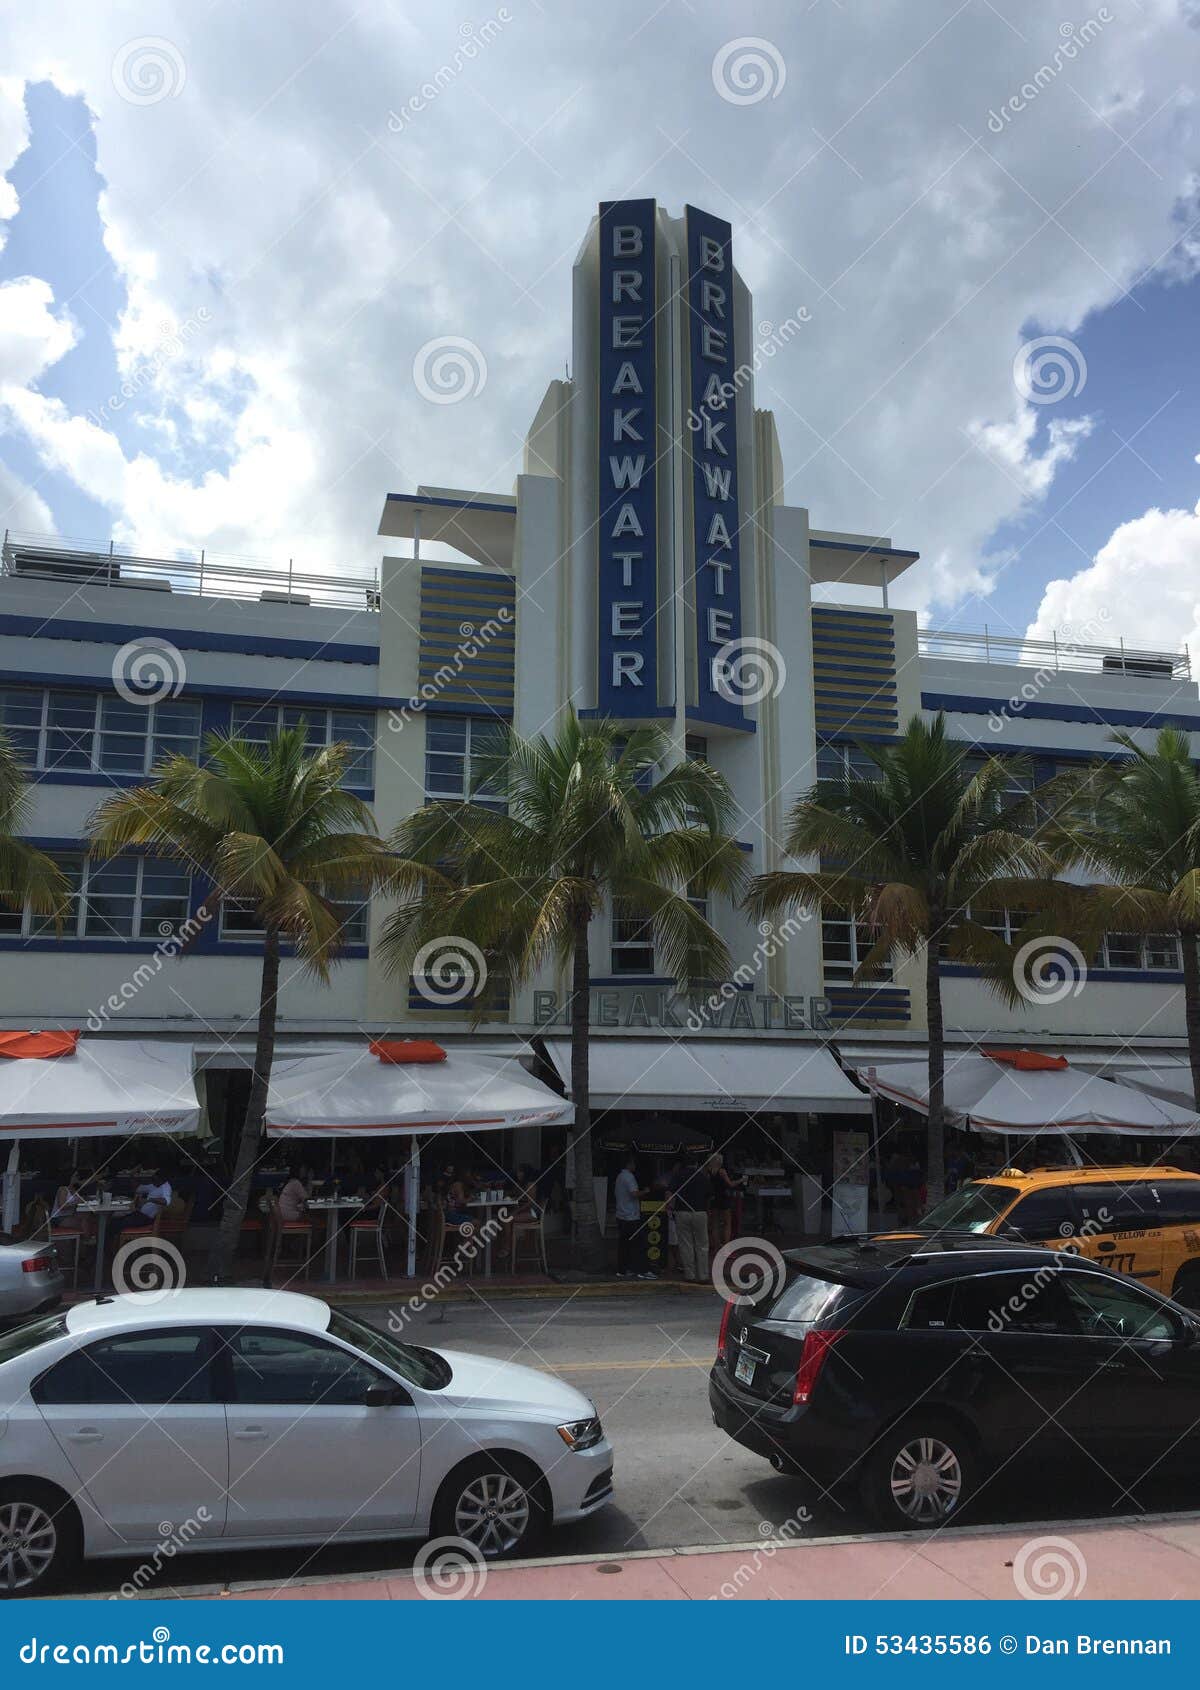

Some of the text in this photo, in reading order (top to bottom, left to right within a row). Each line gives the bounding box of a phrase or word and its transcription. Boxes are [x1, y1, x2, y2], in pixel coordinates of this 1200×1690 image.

[608, 224, 645, 688] BREAKWATER
[700, 235, 735, 697] BREAKWATER
[1112, 1230, 1146, 1240] YELLOW
